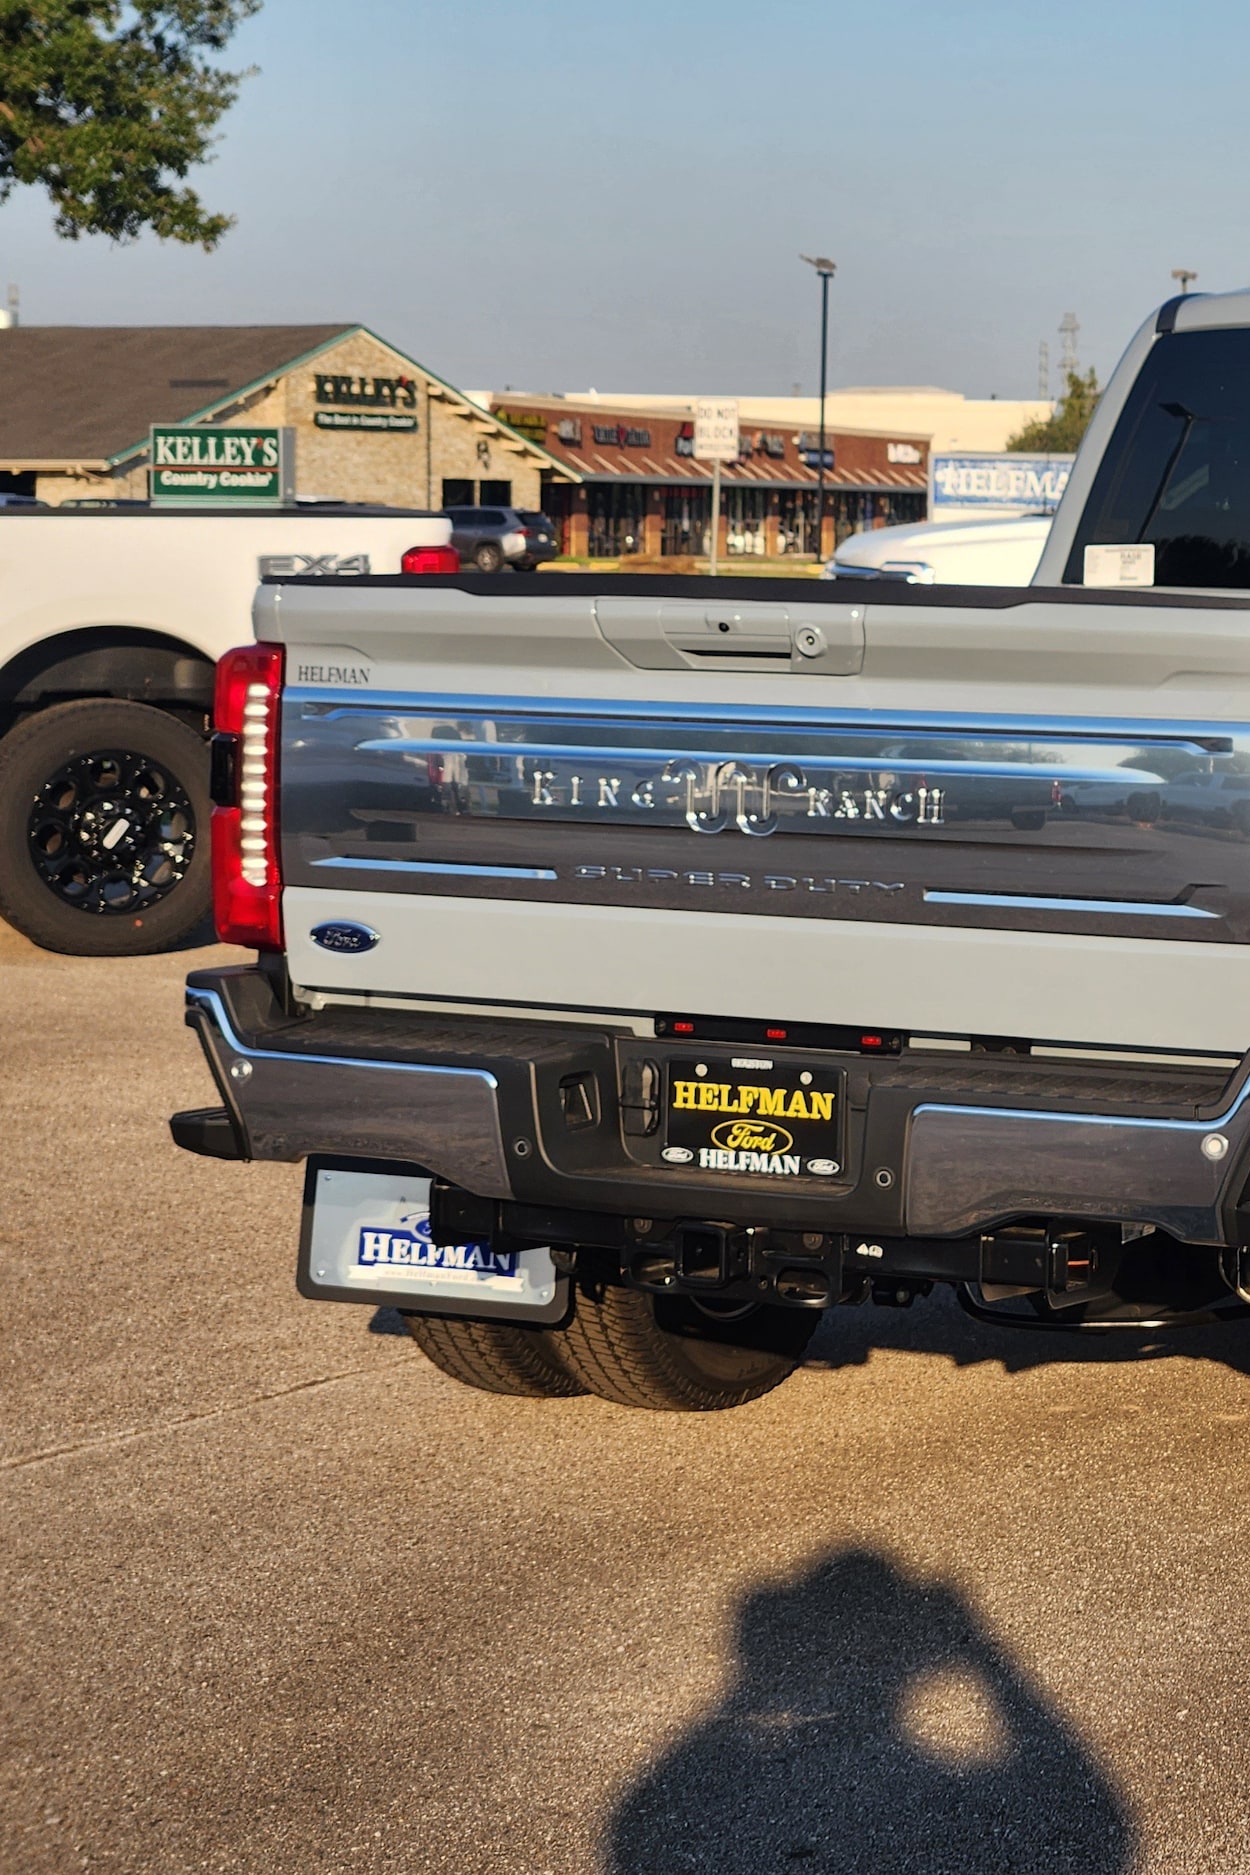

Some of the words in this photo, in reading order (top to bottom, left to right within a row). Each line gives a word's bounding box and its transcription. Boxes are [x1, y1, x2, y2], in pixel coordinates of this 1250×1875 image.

[156, 436, 278, 466] KELLEY'S
[161, 470, 218, 489] Country
[220, 471, 273, 487] Cookin'
[298, 664, 370, 684] HELFMAN
[533, 769, 655, 809] KING
[806, 786, 946, 824] RANCH
[575, 864, 751, 888] SUPER
[764, 875, 906, 895] DUTY
[323, 926, 361, 948] Ford
[672, 1081, 835, 1120] HELFMAN
[726, 1122, 777, 1151] Ford
[699, 1147, 802, 1175] HELFMAN
